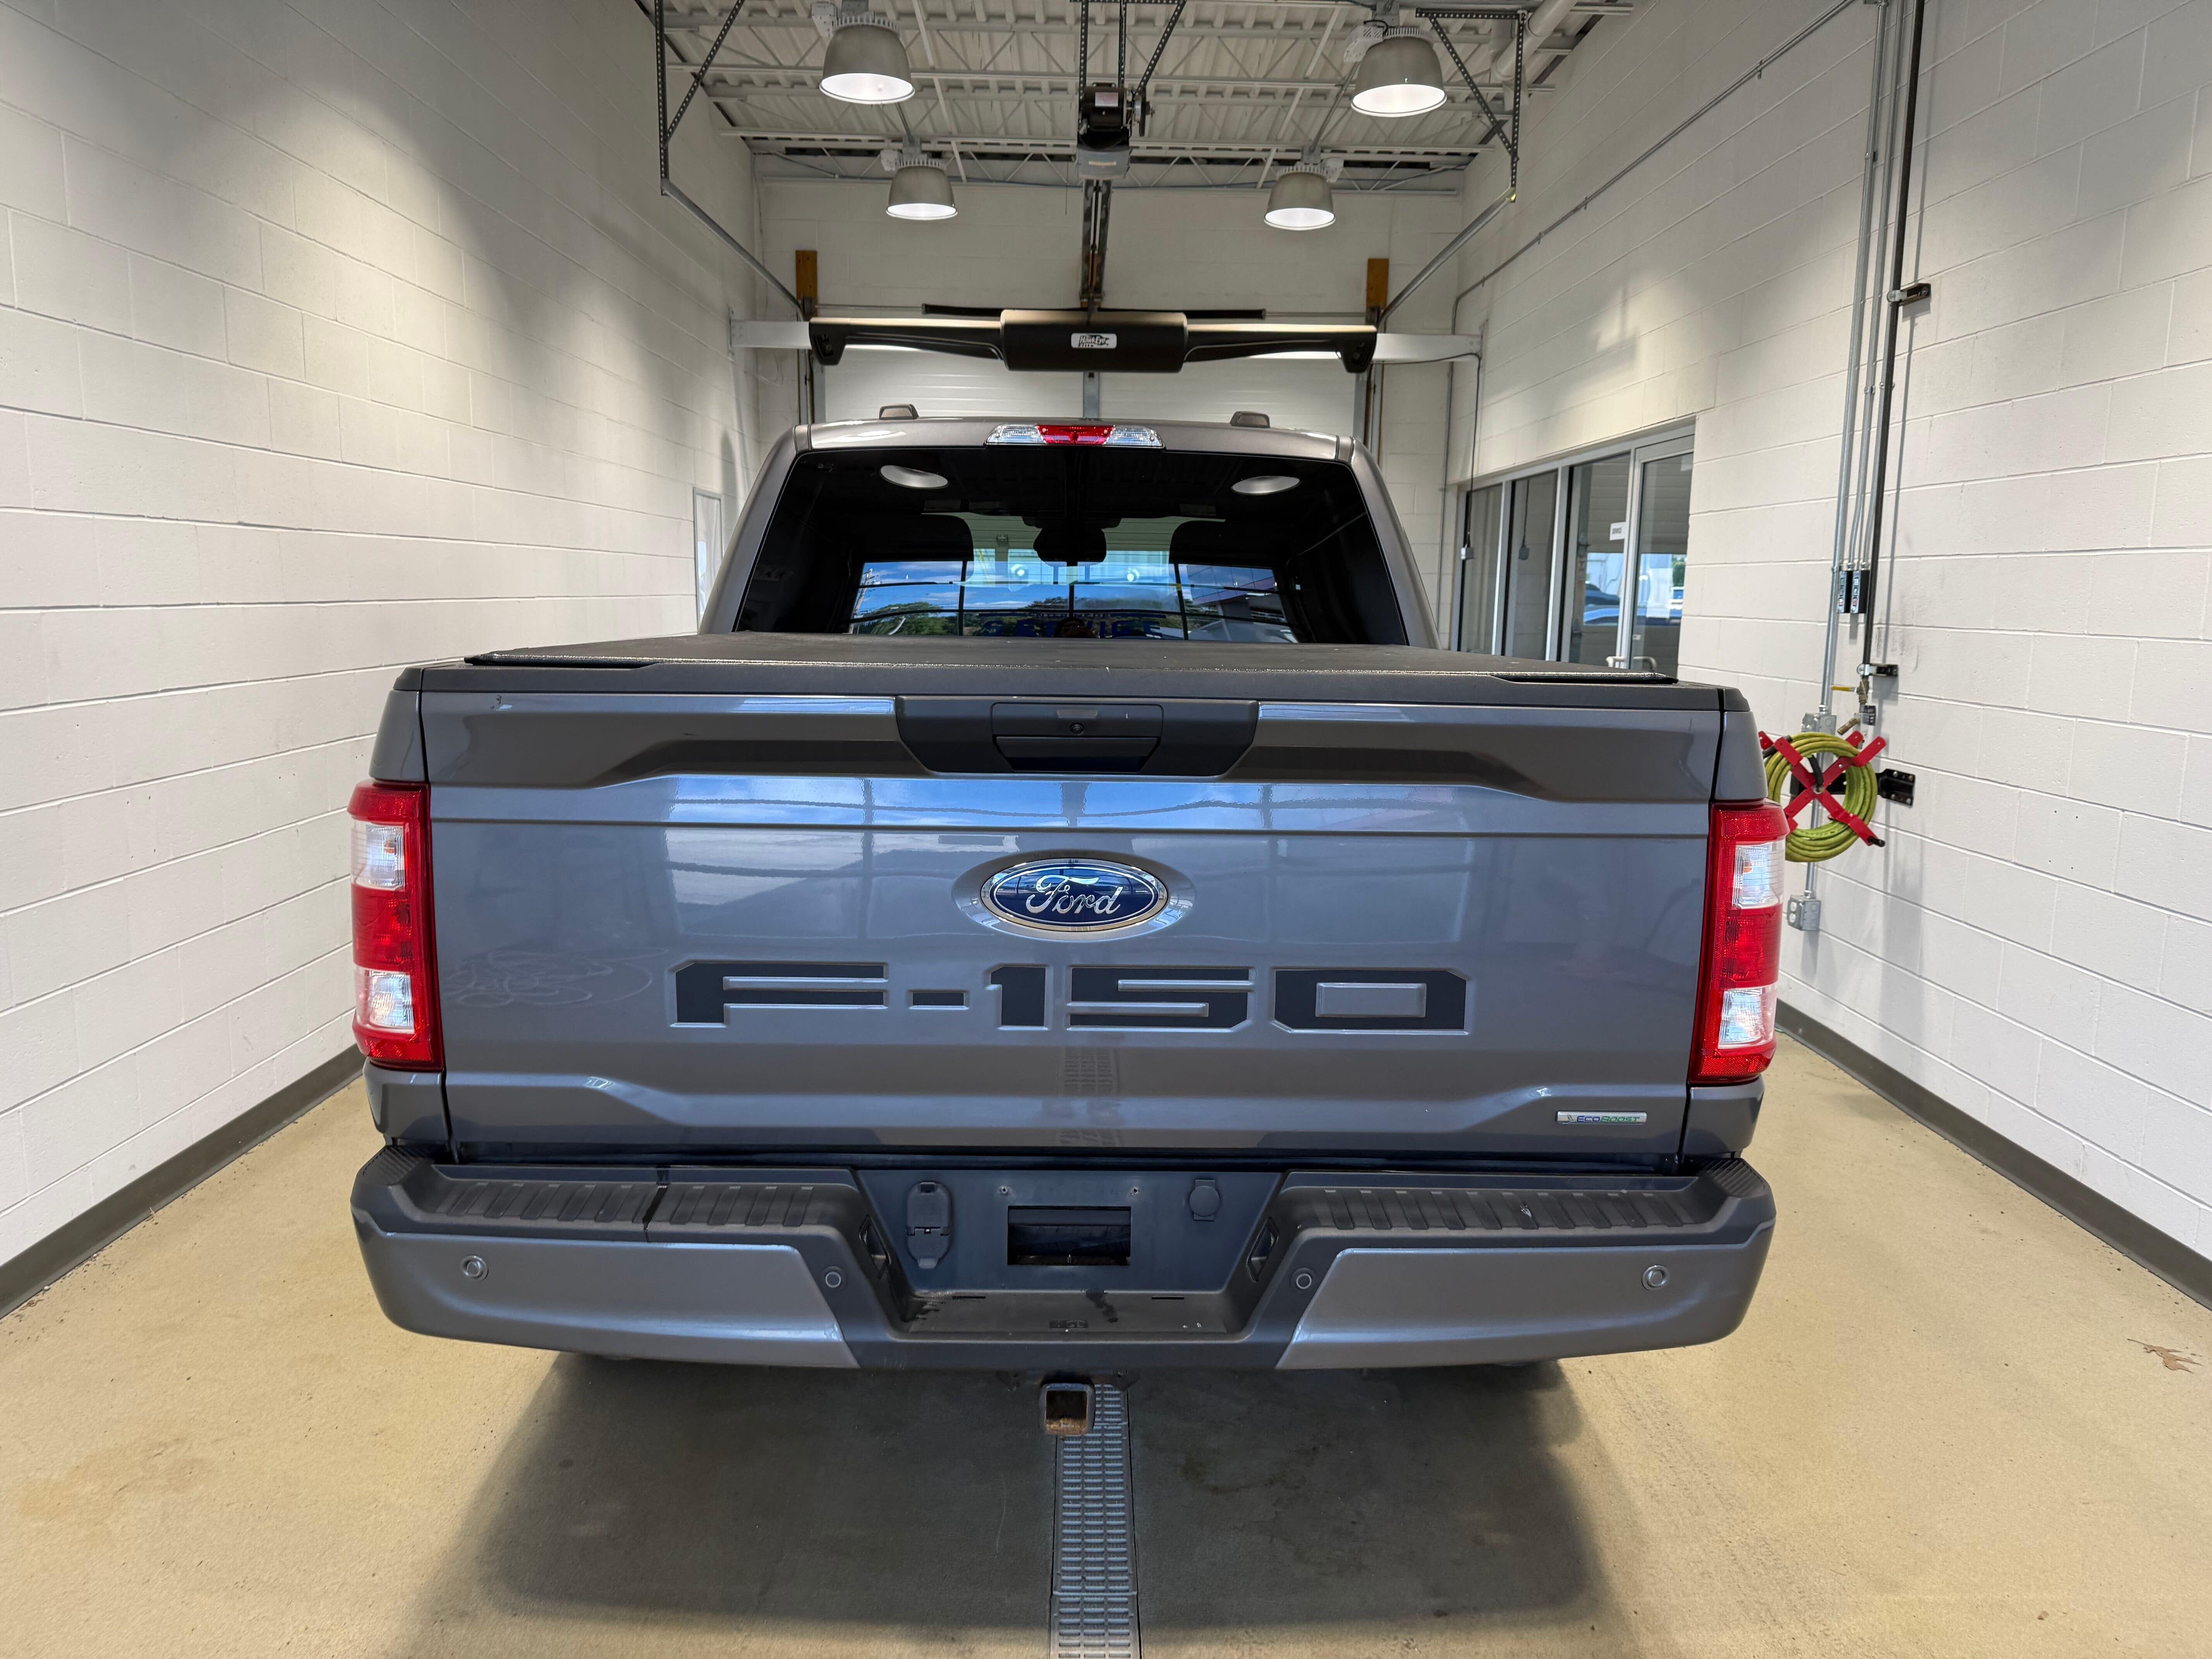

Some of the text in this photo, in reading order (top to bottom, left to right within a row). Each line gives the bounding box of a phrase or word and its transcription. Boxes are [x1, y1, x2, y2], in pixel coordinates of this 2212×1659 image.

[984, 620, 1163, 638] SEICE
[1025, 874, 1124, 914] Ford
[673, 961, 1468, 1032] F-150
